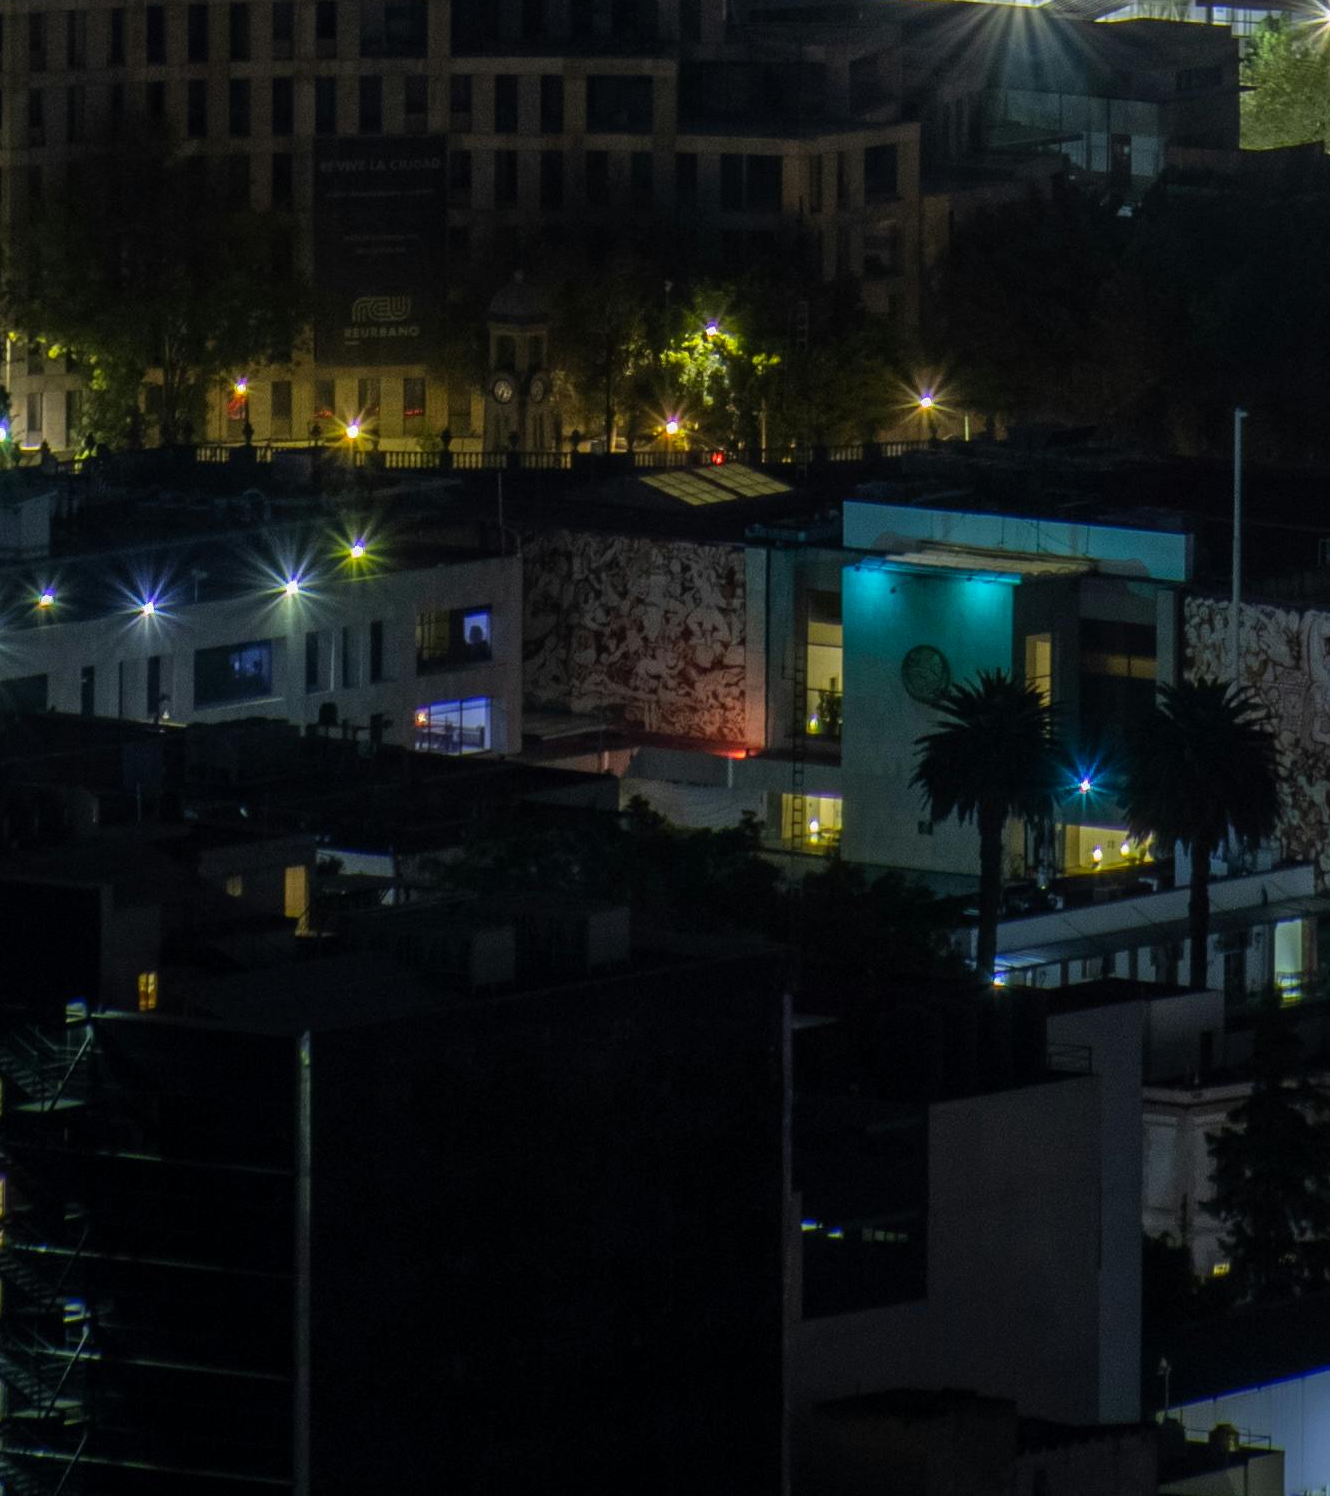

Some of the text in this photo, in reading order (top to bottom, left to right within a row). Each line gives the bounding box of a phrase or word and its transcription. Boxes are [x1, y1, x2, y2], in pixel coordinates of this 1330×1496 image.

[319, 157, 440, 172] REVIVE LA CIUDAD
[344, 326, 420, 339] REURBANO
